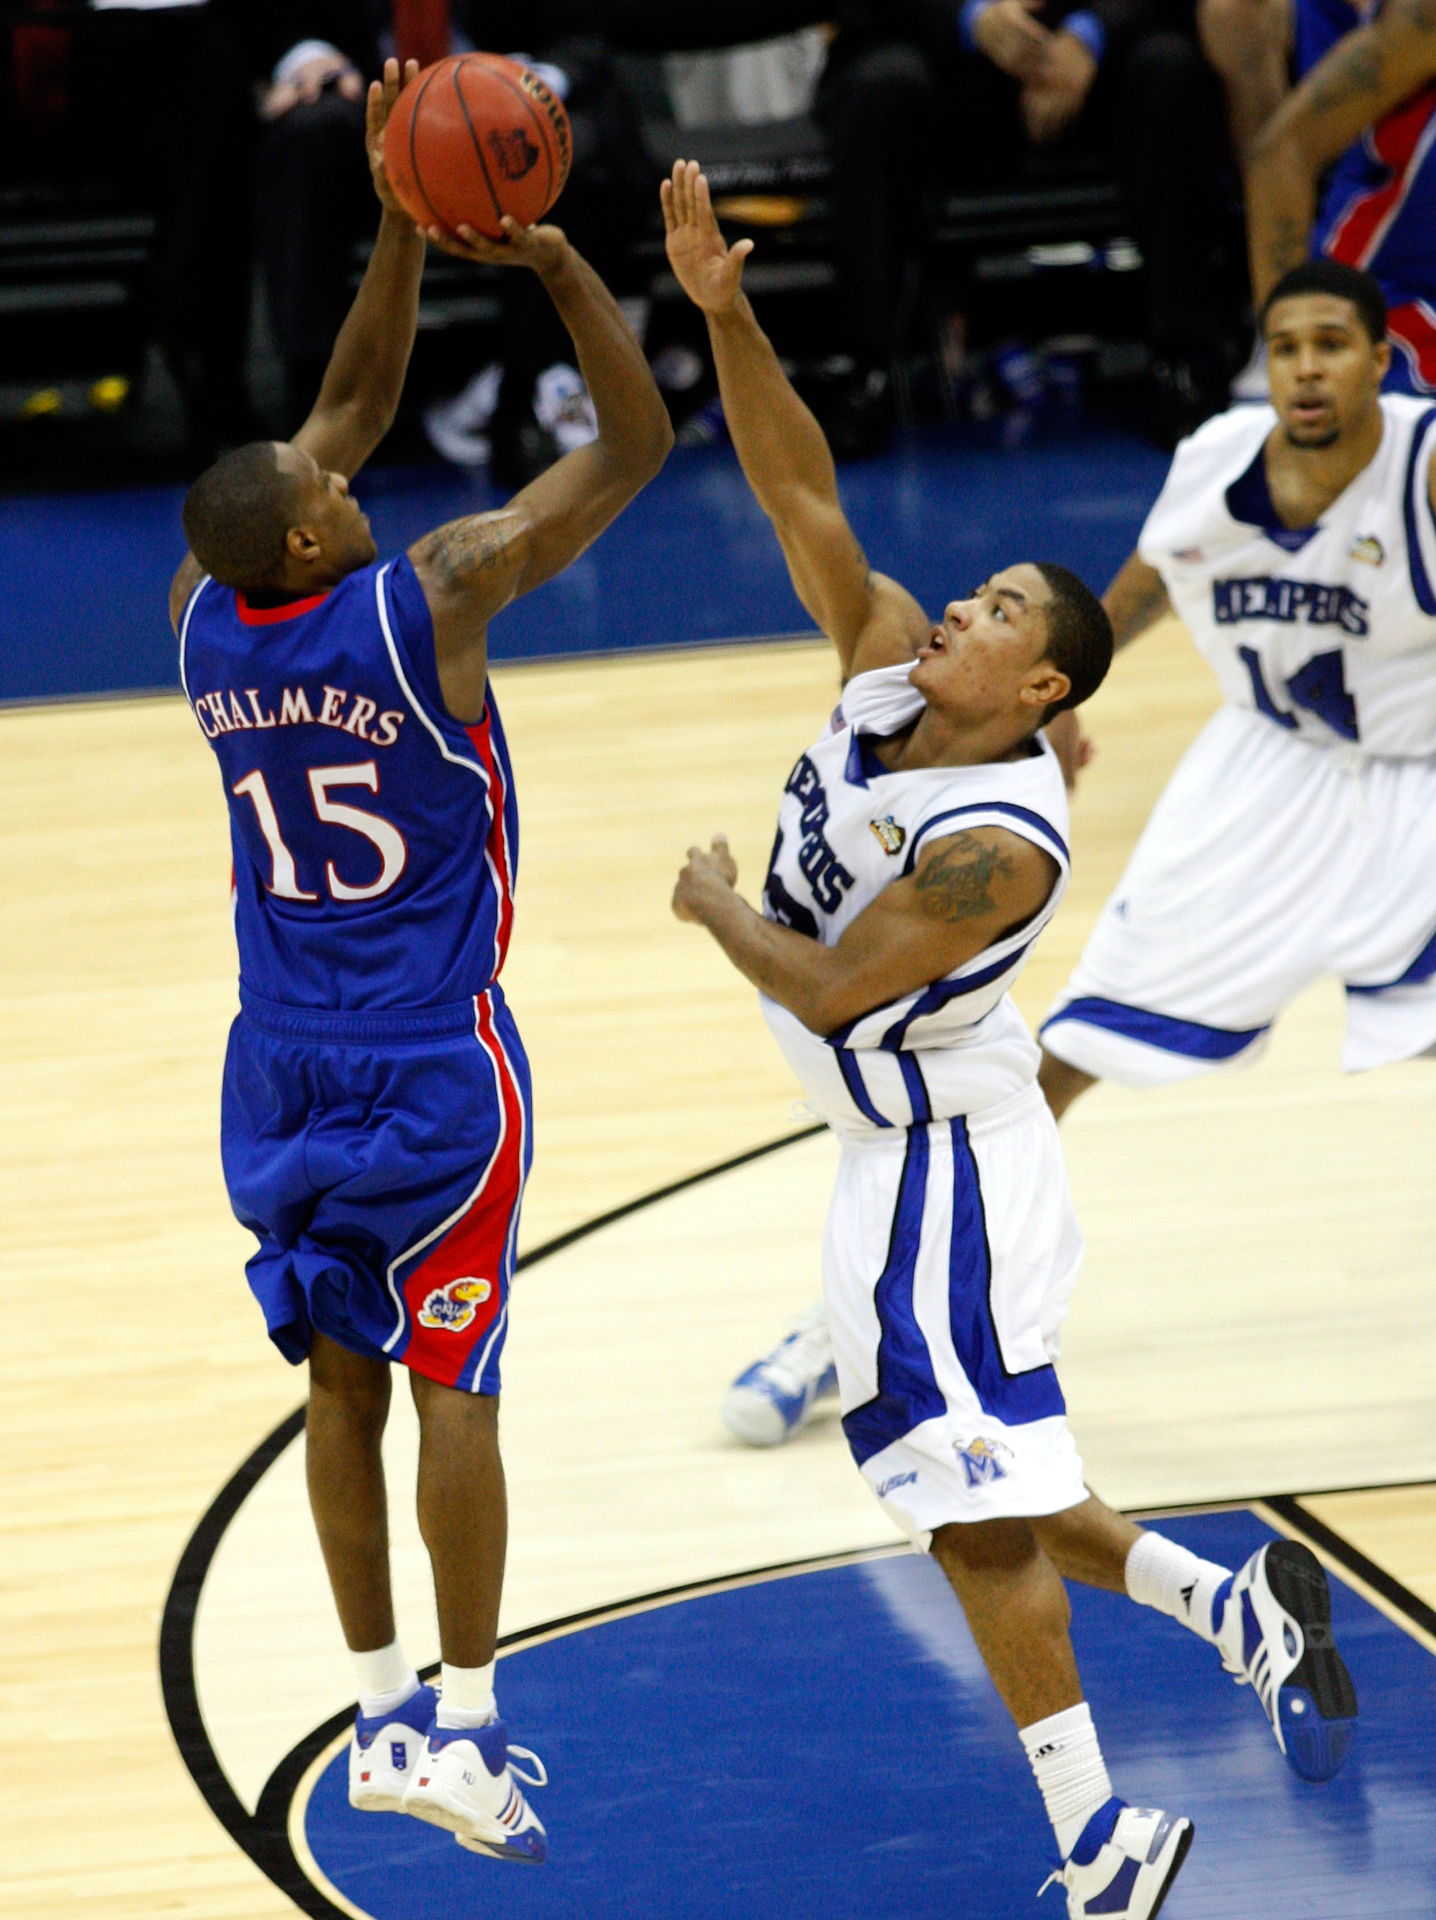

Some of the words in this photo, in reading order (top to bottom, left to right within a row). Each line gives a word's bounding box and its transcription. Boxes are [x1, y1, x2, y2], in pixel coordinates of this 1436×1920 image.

[195, 685, 405, 746] CHALMERS
[1238, 645, 1360, 742] 14
[232, 759, 409, 903] 15
[956, 1448, 1008, 1490] M
